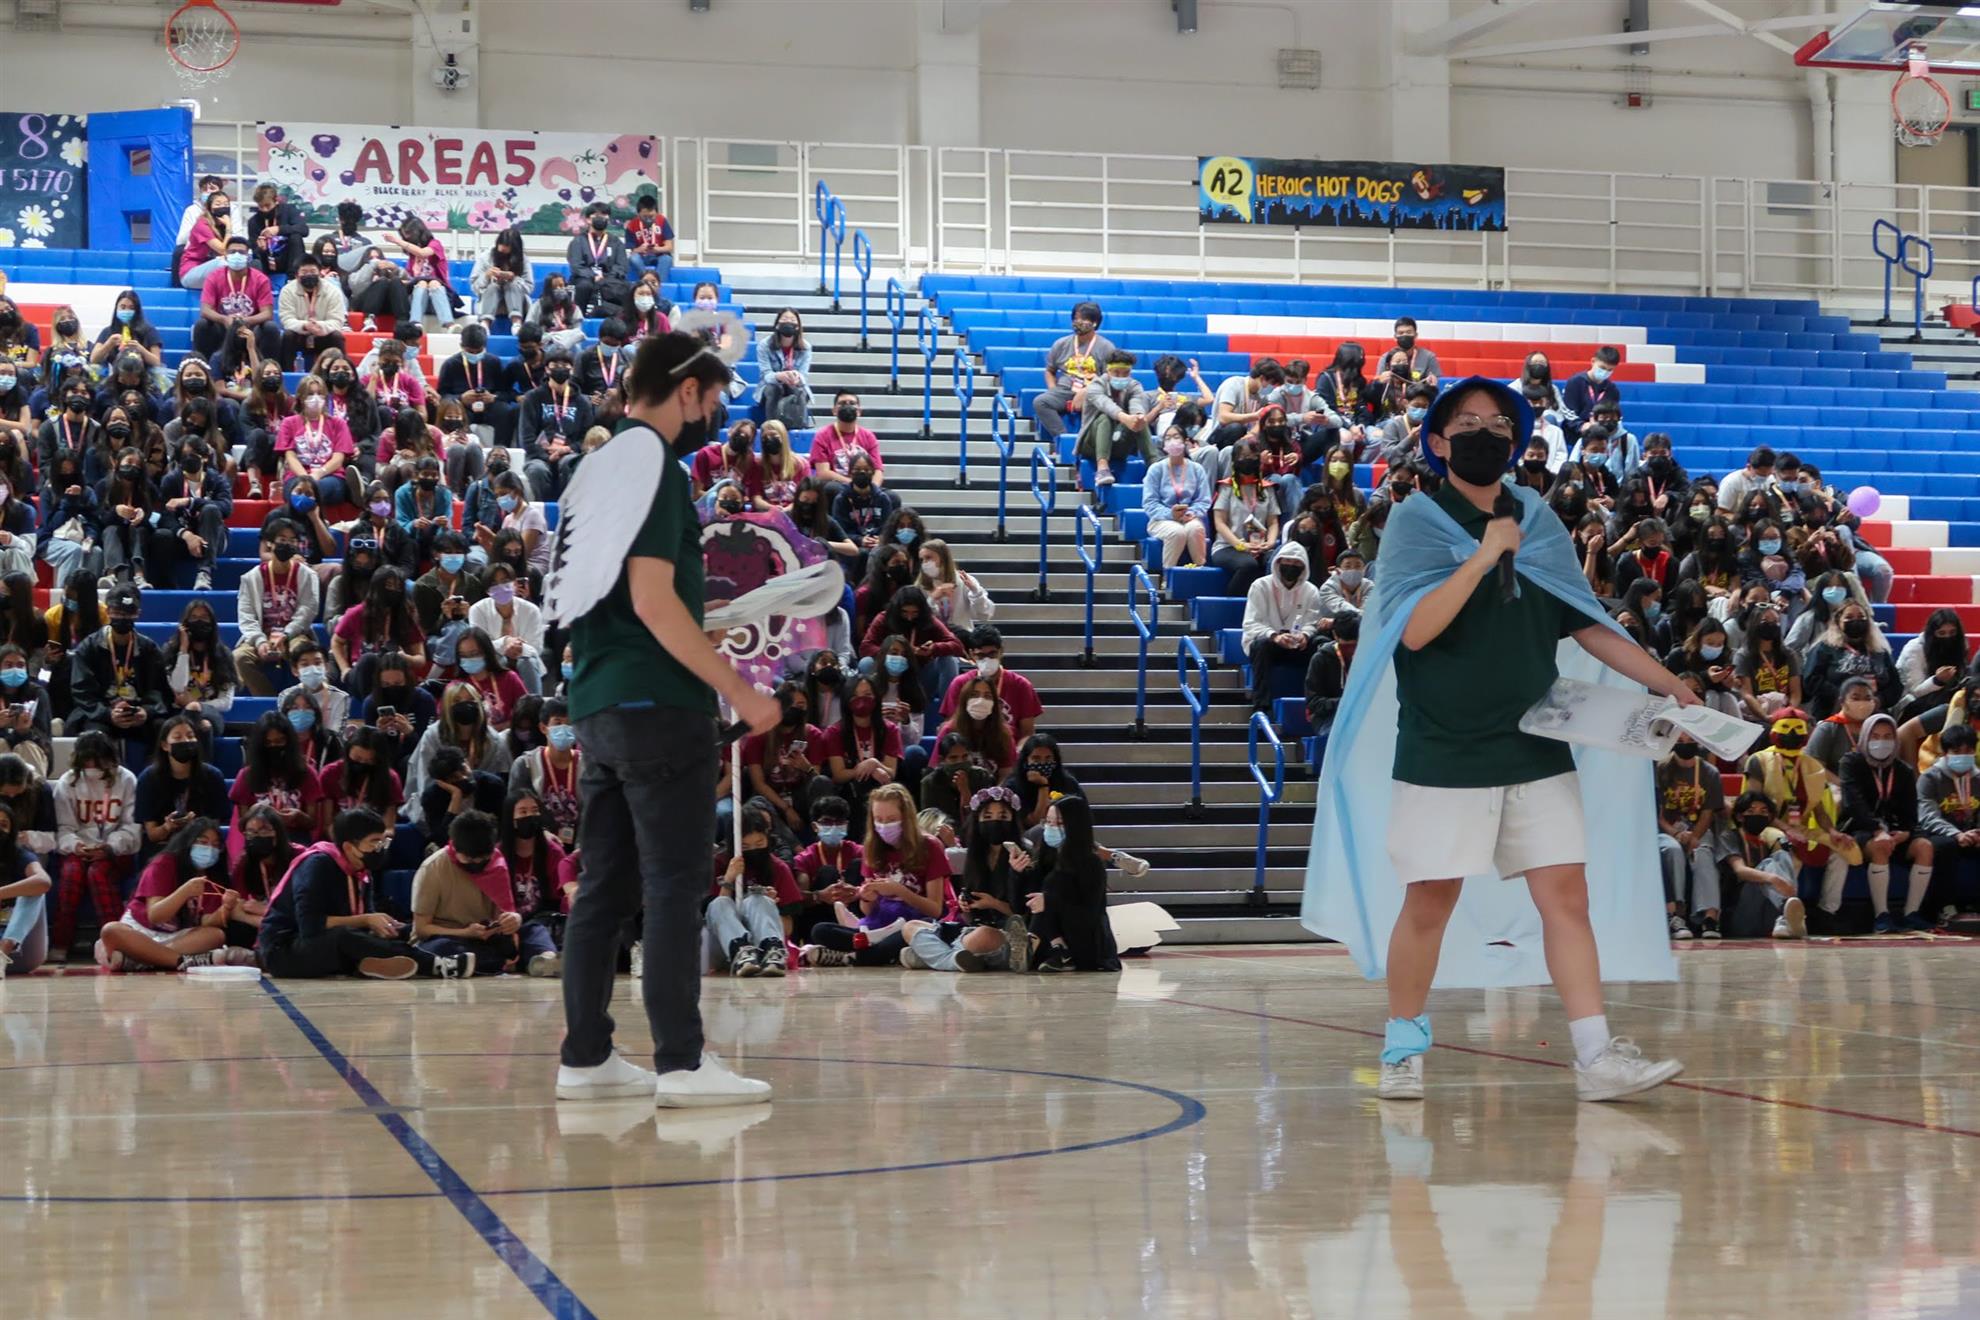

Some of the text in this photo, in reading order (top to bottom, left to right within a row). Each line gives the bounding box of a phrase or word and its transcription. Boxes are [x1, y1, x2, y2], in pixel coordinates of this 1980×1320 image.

[18, 114, 49, 160] 8
[12, 168, 74, 194] 5170
[1210, 167, 1244, 196] A2
[1255, 173, 1405, 203] HEROIC HOT DOGS
[76, 798, 122, 824] USC
